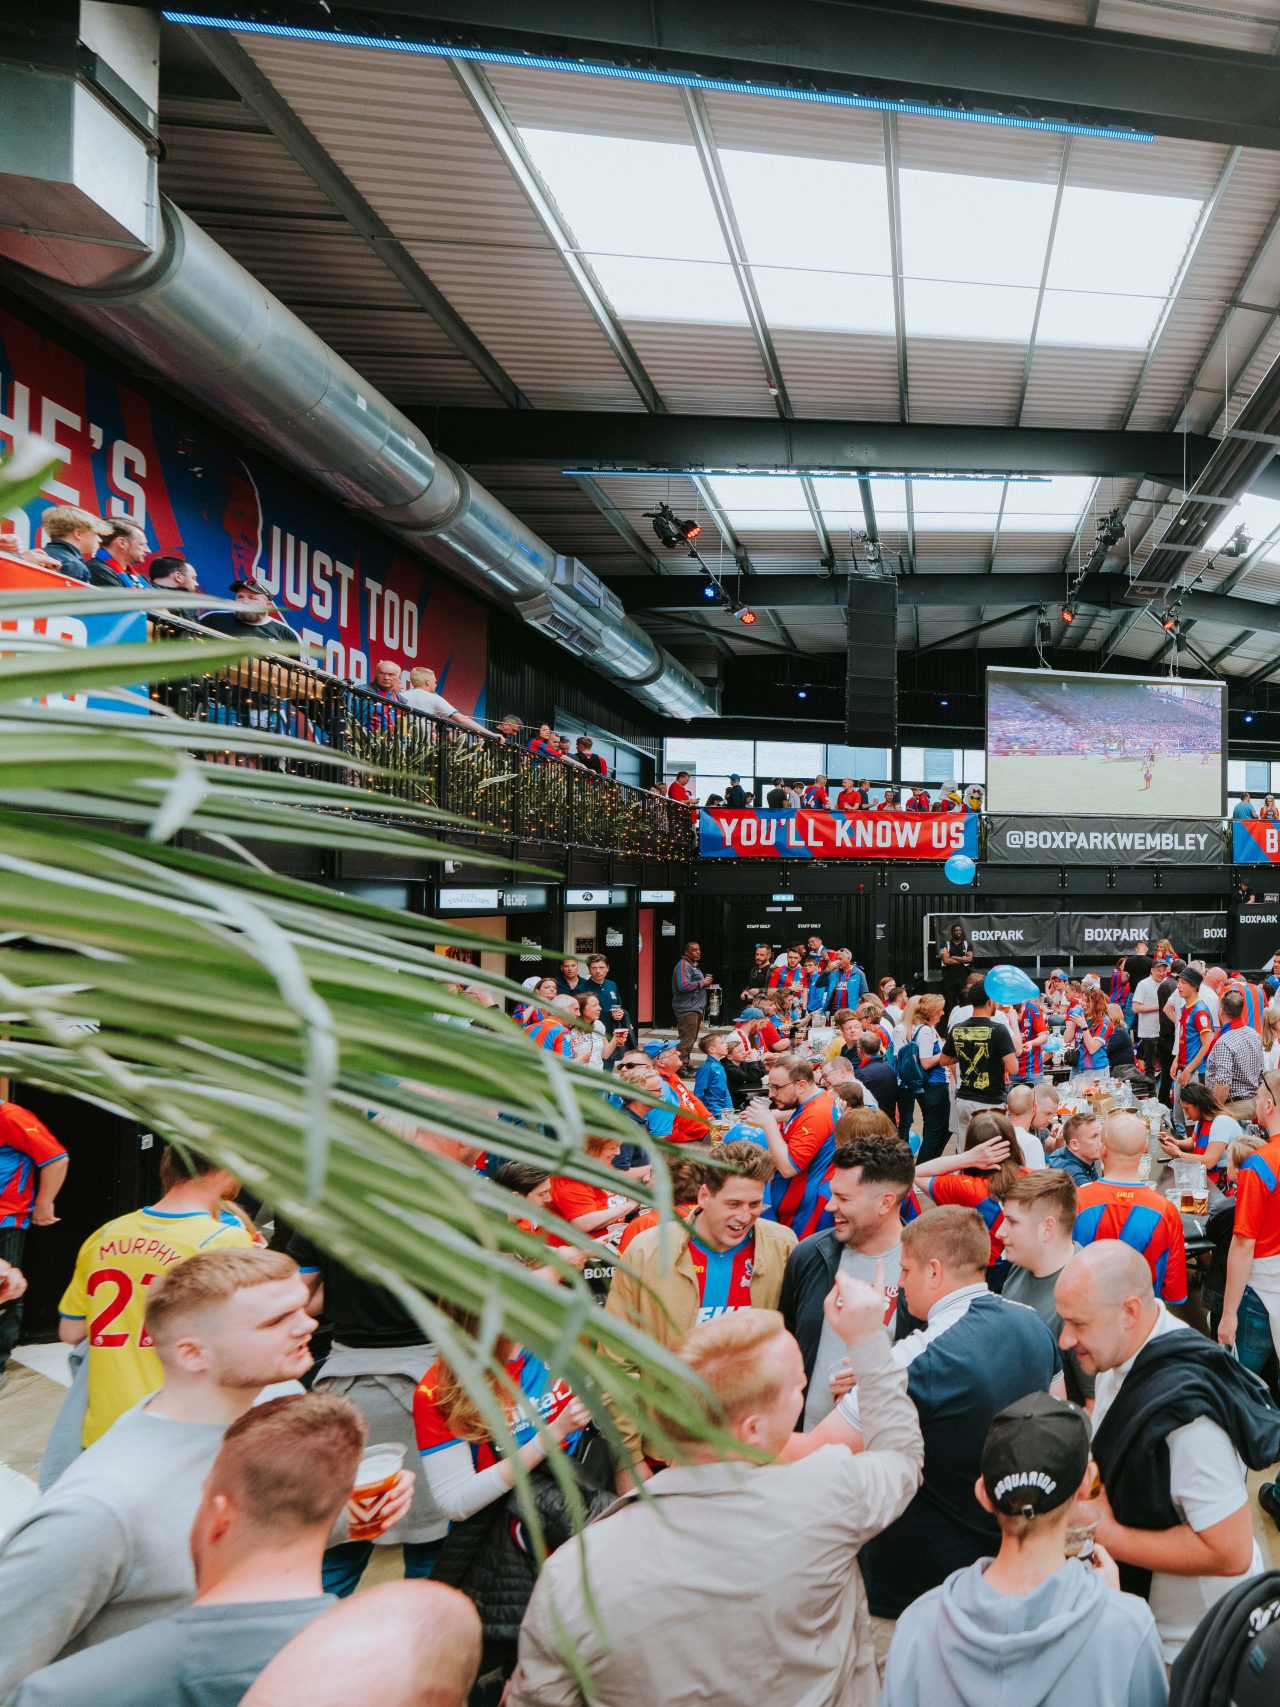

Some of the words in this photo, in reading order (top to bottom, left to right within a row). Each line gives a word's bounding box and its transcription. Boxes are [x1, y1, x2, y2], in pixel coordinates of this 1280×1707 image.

[257, 525, 354, 628] JUST
[365, 577, 419, 659] TOO
[720, 818, 824, 846] YOU'LL
[835, 819, 921, 848] KNOW
[932, 822, 965, 849] US
[1006, 829, 1208, 851] @BOXPARKWEMBLEY
[1239, 915, 1278, 924] BOXPARK
[971, 930, 1024, 941] BOXPARK
[1084, 927, 1149, 941] BOXPARK
[100, 1238, 181, 1265] MURPHY
[87, 1268, 156, 1347] 2
